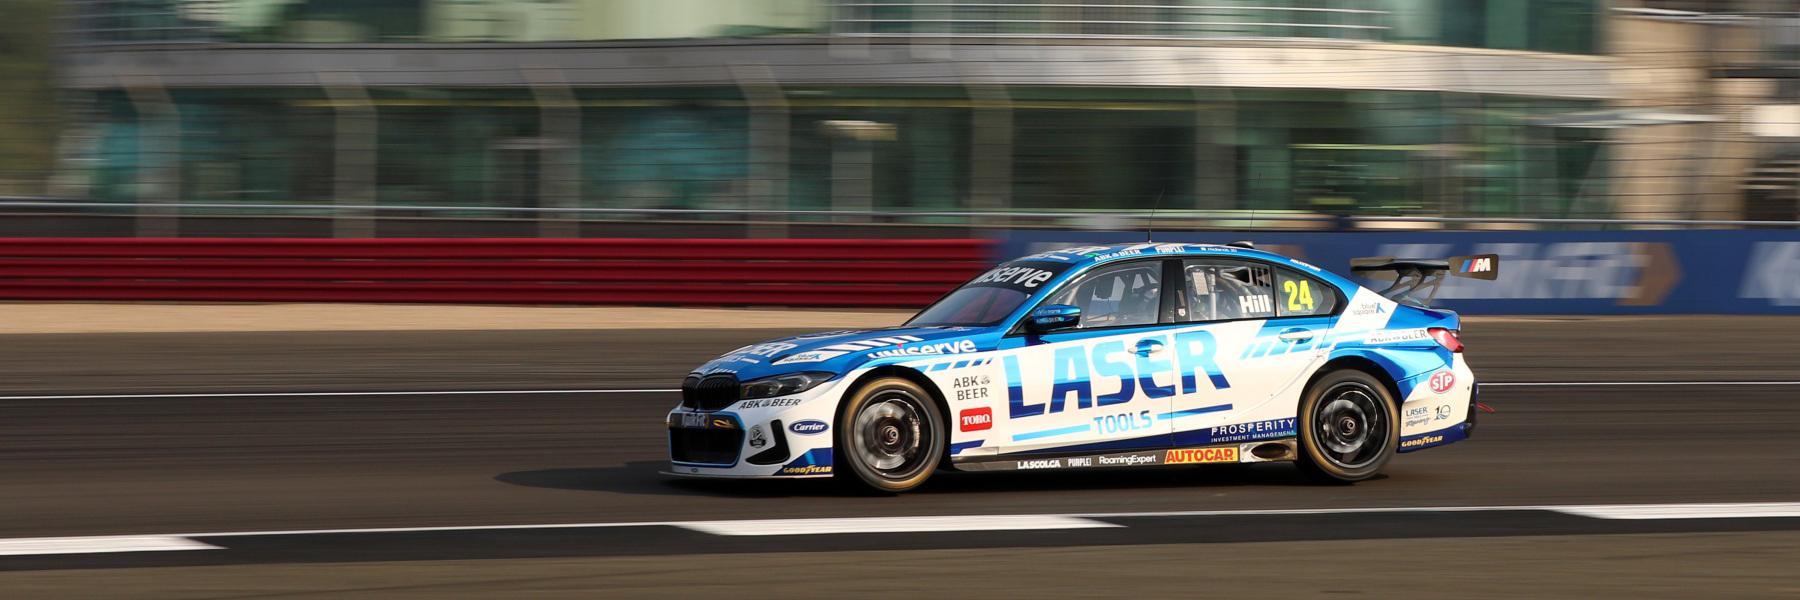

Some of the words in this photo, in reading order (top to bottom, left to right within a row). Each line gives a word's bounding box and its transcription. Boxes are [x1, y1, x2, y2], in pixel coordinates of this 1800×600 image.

[1284, 280, 1313, 311] 24
[1239, 294, 1271, 313] Hill
[1002, 330, 1231, 419] LASER
[1432, 371, 1454, 390] STP
[953, 375, 979, 389] ABK
[957, 387, 989, 401] BEER
[738, 400, 763, 410] ABK
[770, 398, 801, 407] BEER
[1405, 407, 1427, 416] LASER
[793, 422, 825, 432] Carrier
[1094, 409, 1153, 435] TOOLS
[1211, 418, 1295, 436] PROSPERITY
[1211, 434, 1250, 443] INVESTMENT
[1401, 435, 1443, 447] GOODYEAR
[1098, 454, 1157, 466] RoamingExpert
[1166, 448, 1234, 463] AUTOCAR
[783, 464, 832, 474] GOODYEAR
[1017, 460, 1061, 470] LASCOLCA
